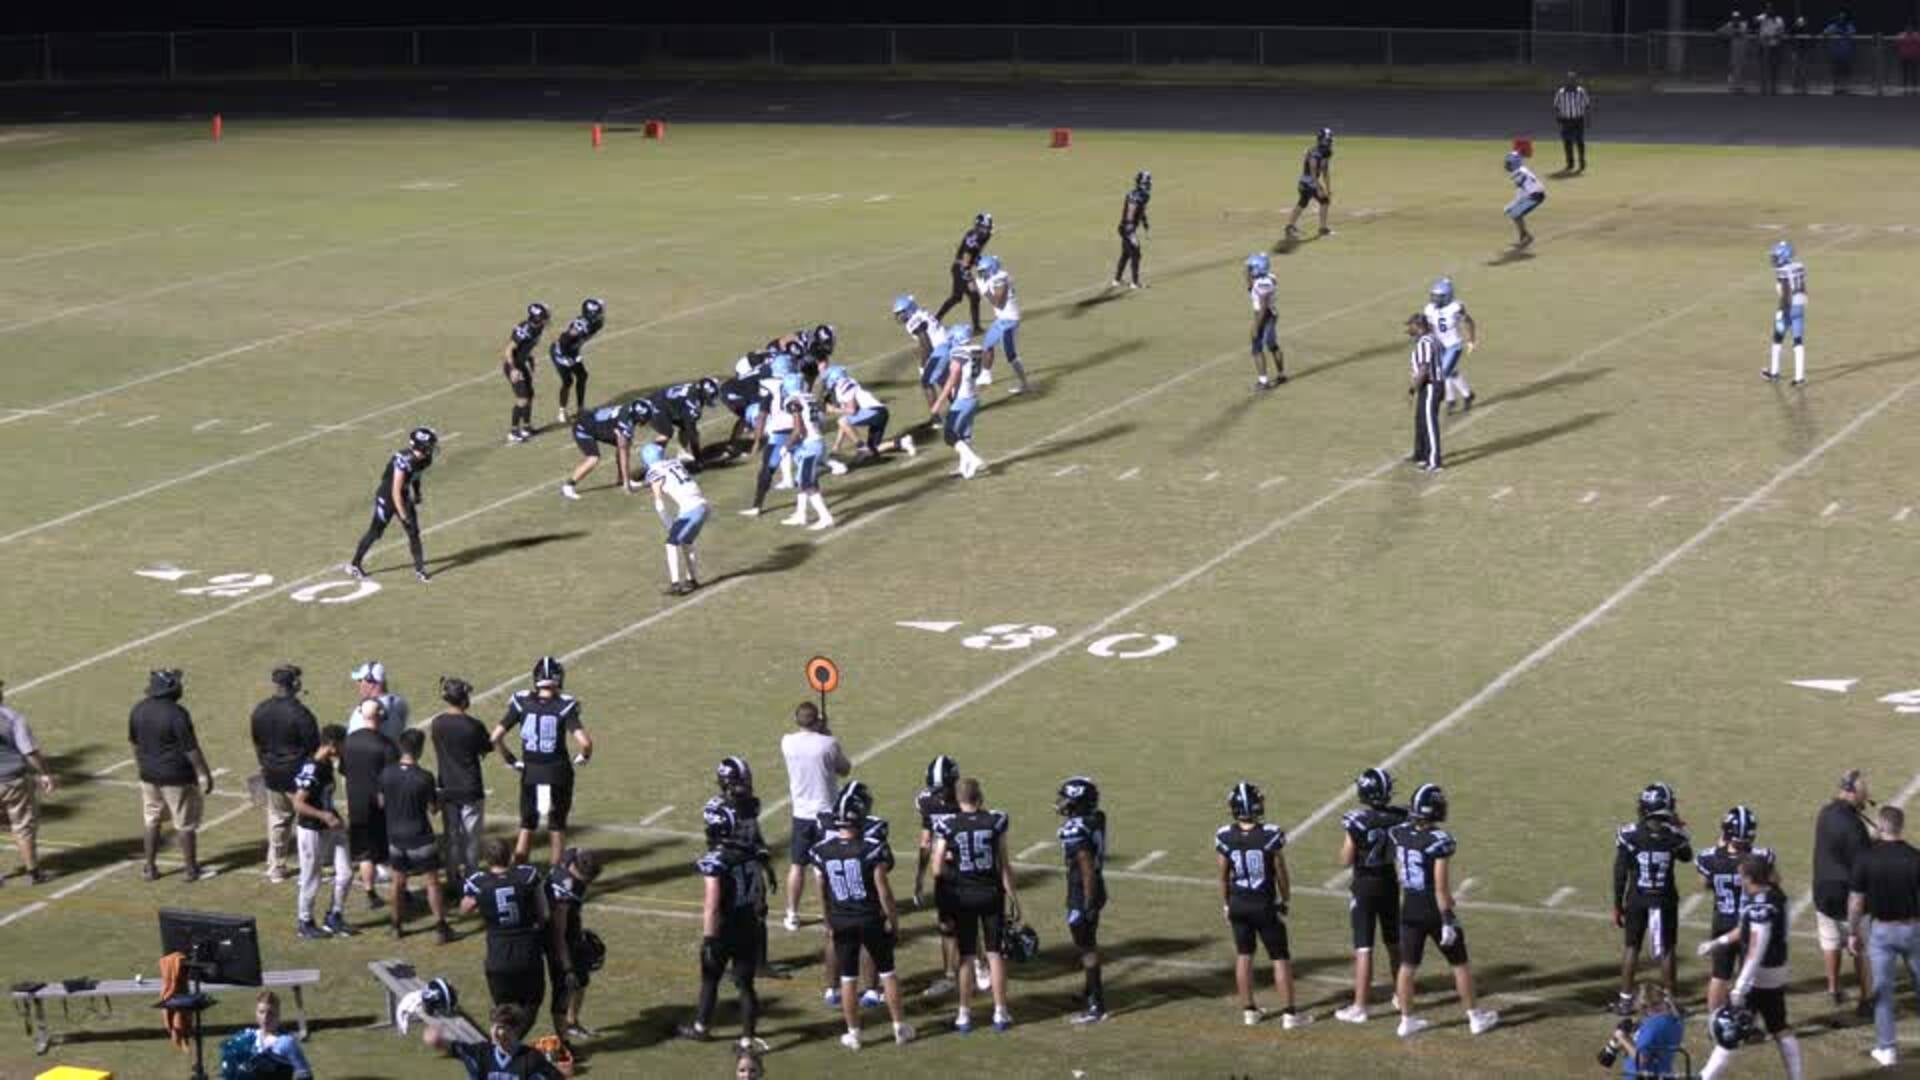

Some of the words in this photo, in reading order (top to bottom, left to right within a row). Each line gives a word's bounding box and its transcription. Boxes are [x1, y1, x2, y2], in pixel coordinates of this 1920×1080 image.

[956, 829, 993, 872] 15
[1635, 851, 1671, 888] 17
[495, 886, 520, 926] 5
